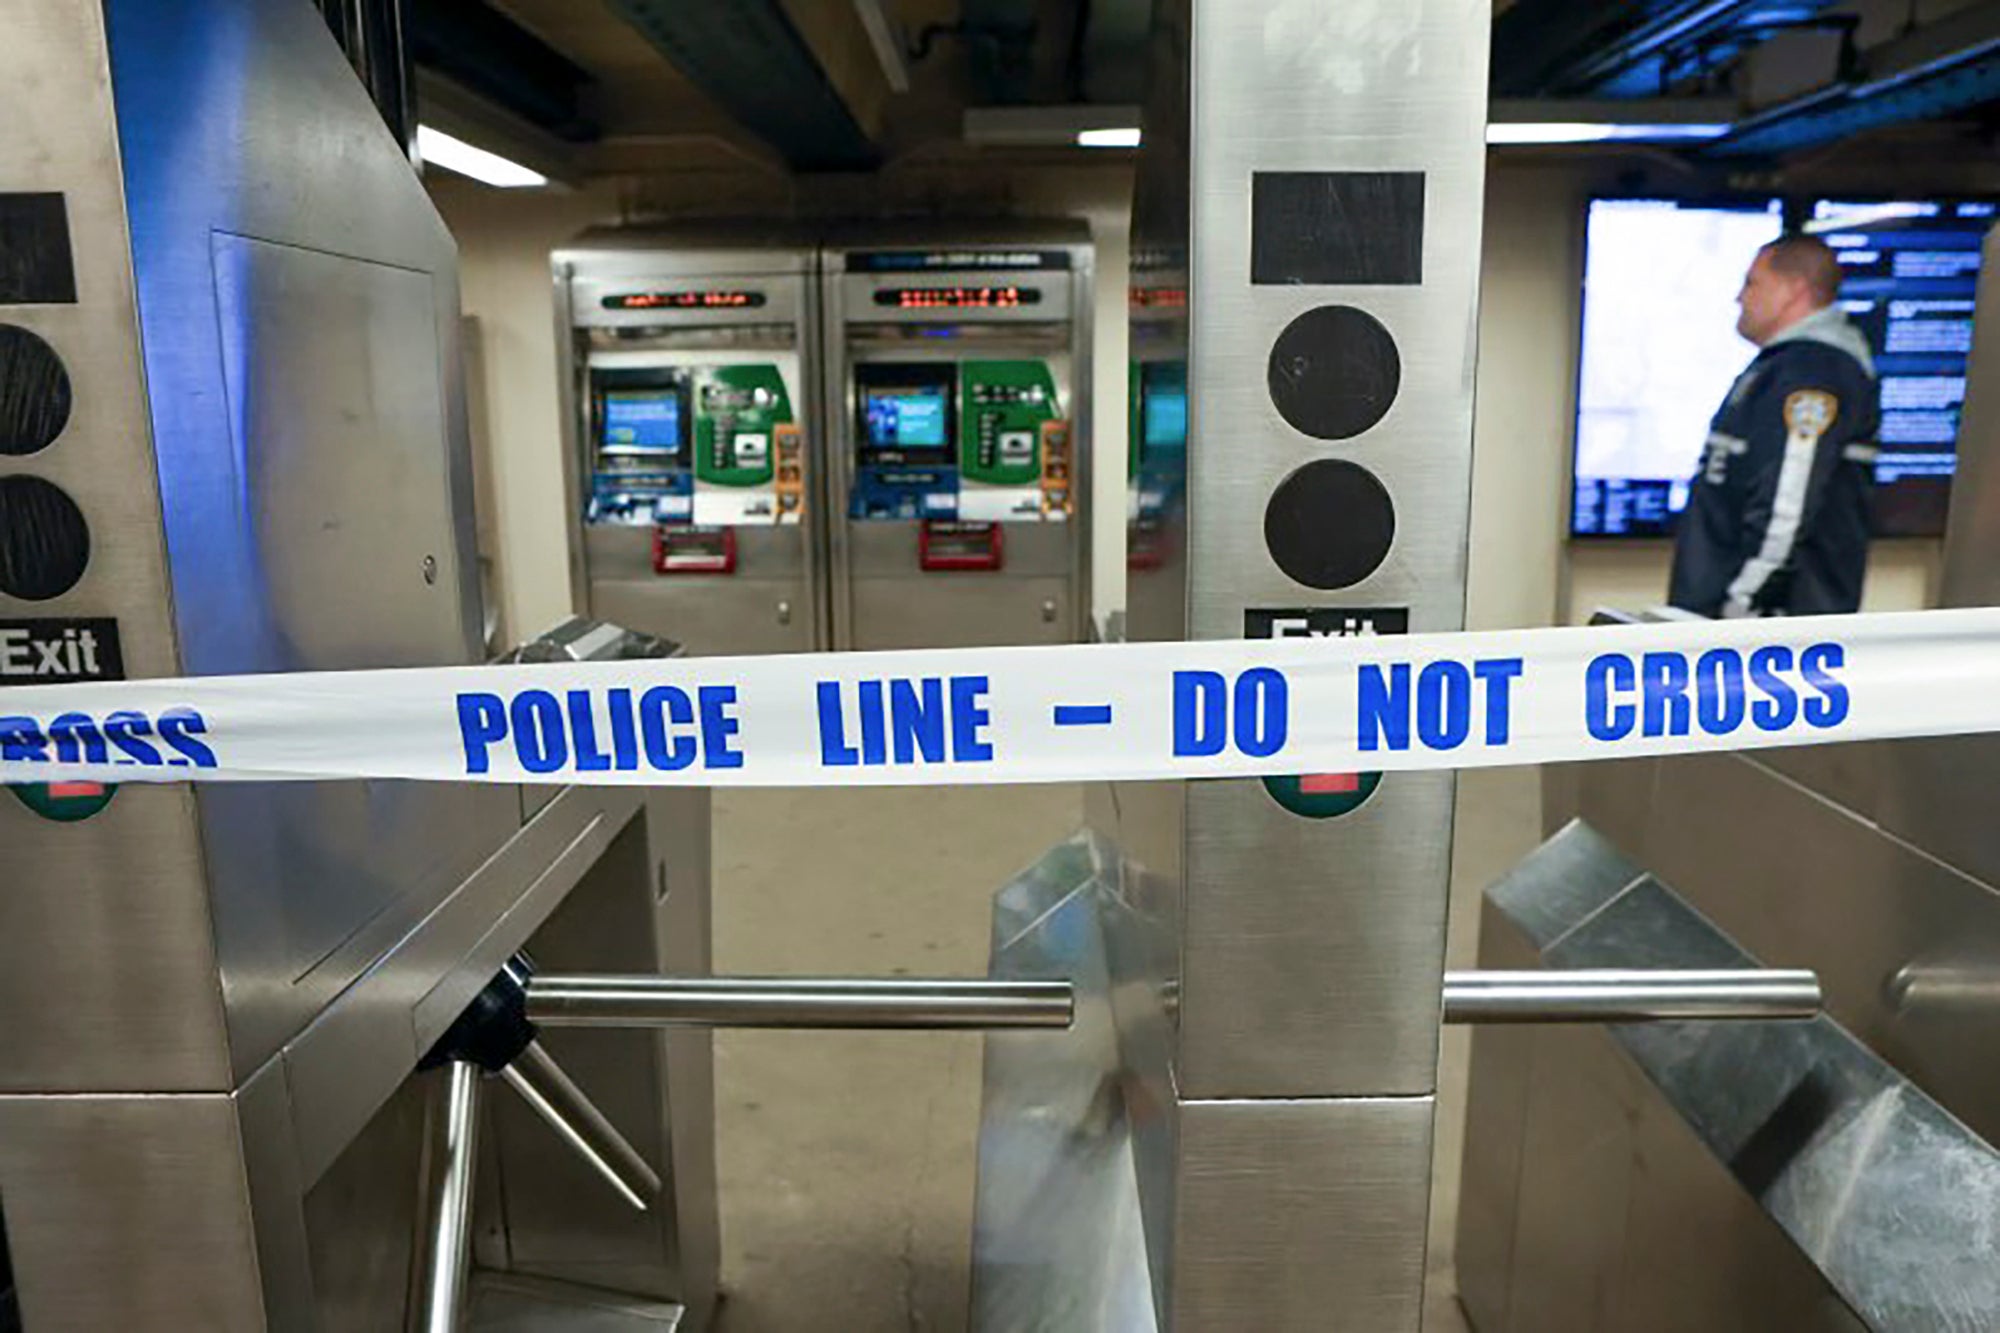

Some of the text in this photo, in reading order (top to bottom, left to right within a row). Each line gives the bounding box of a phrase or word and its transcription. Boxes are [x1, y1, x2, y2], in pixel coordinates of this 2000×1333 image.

[0, 629, 100, 675] Exit
[457, 685, 743, 773] POLICE
[817, 676, 993, 766] LINE
[1173, 667, 1288, 757] DO
[1358, 658, 1523, 751] NOT
[1585, 642, 1849, 741] CROSS
